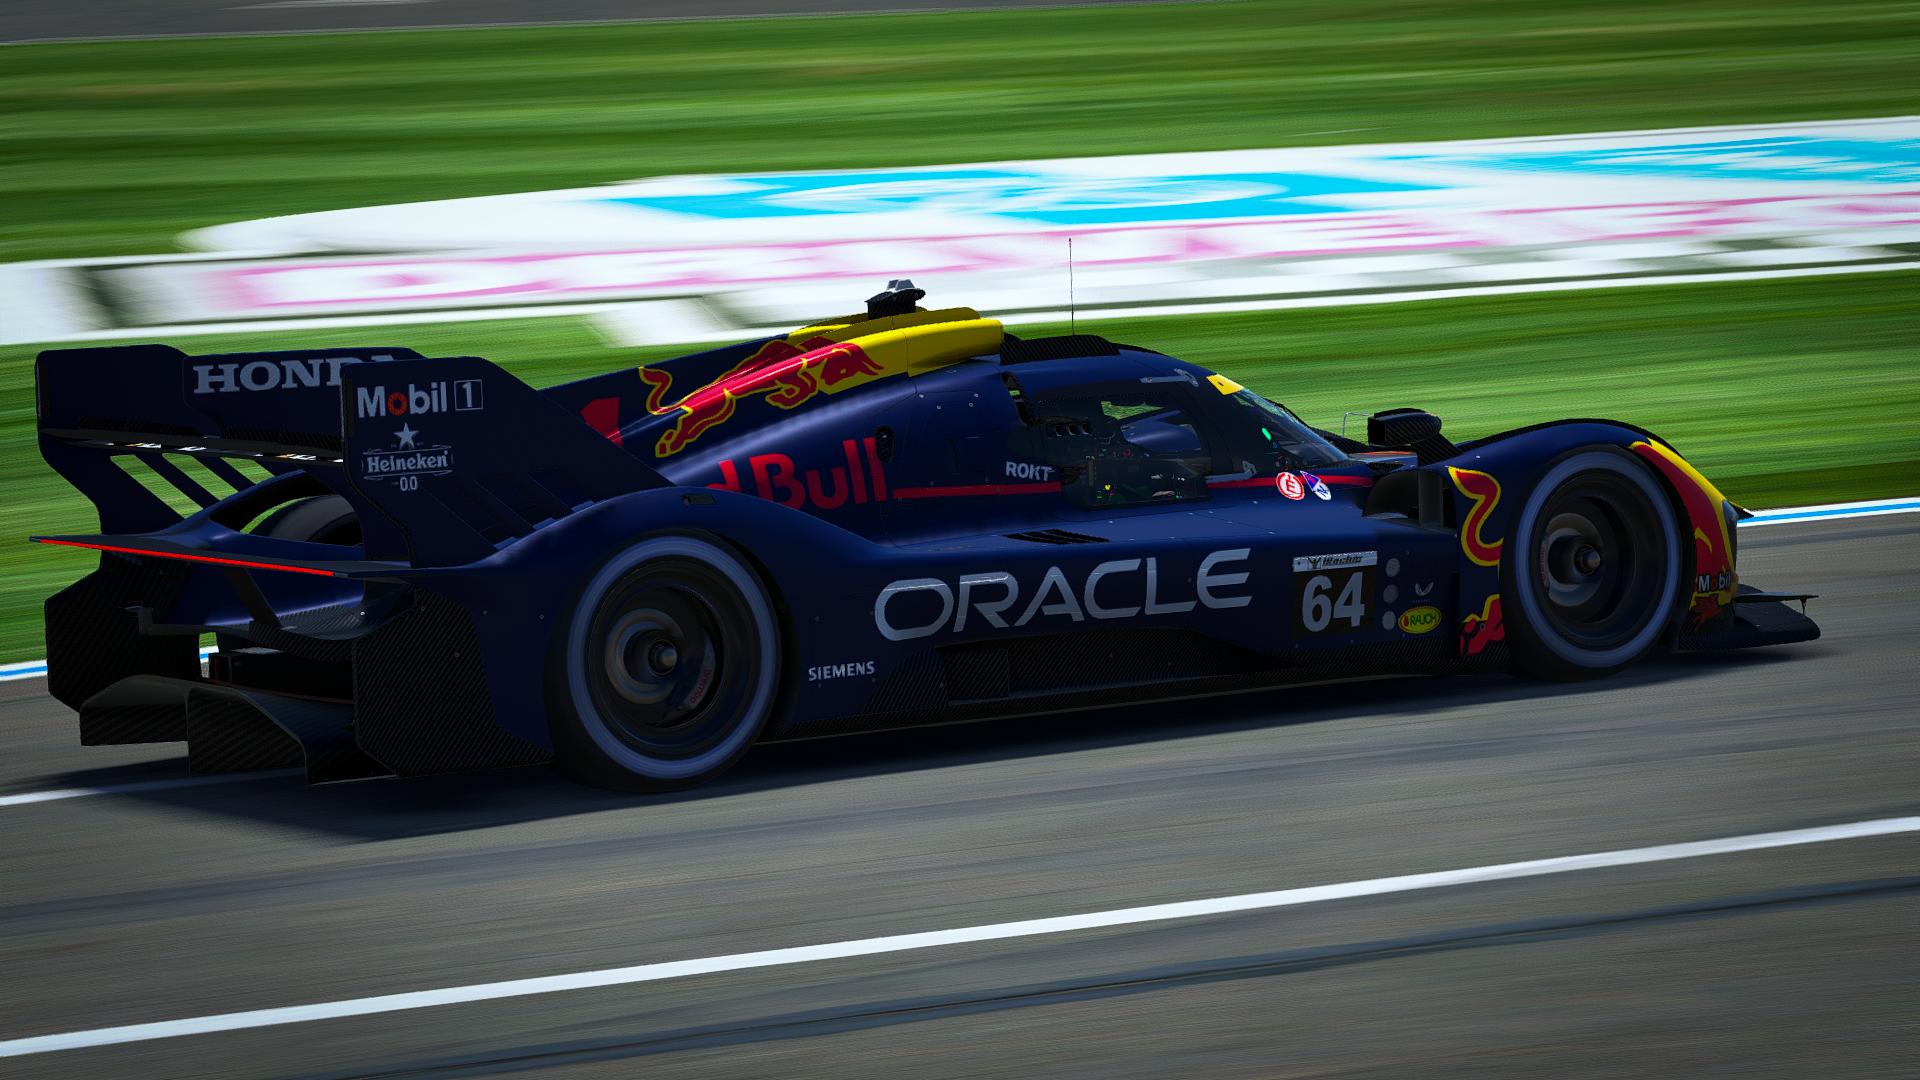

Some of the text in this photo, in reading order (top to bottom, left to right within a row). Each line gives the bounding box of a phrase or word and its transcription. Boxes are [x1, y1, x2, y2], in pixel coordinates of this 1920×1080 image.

[192, 355, 394, 394] HON
[357, 381, 473, 418] Mobil 1
[366, 451, 449, 473] Heineken
[749, 436, 888, 511] Bull
[1005, 460, 1056, 482] ROKT
[874, 547, 1254, 642] ORACLE
[1302, 571, 1365, 633] 64
[808, 661, 875, 682] SIEMENS
